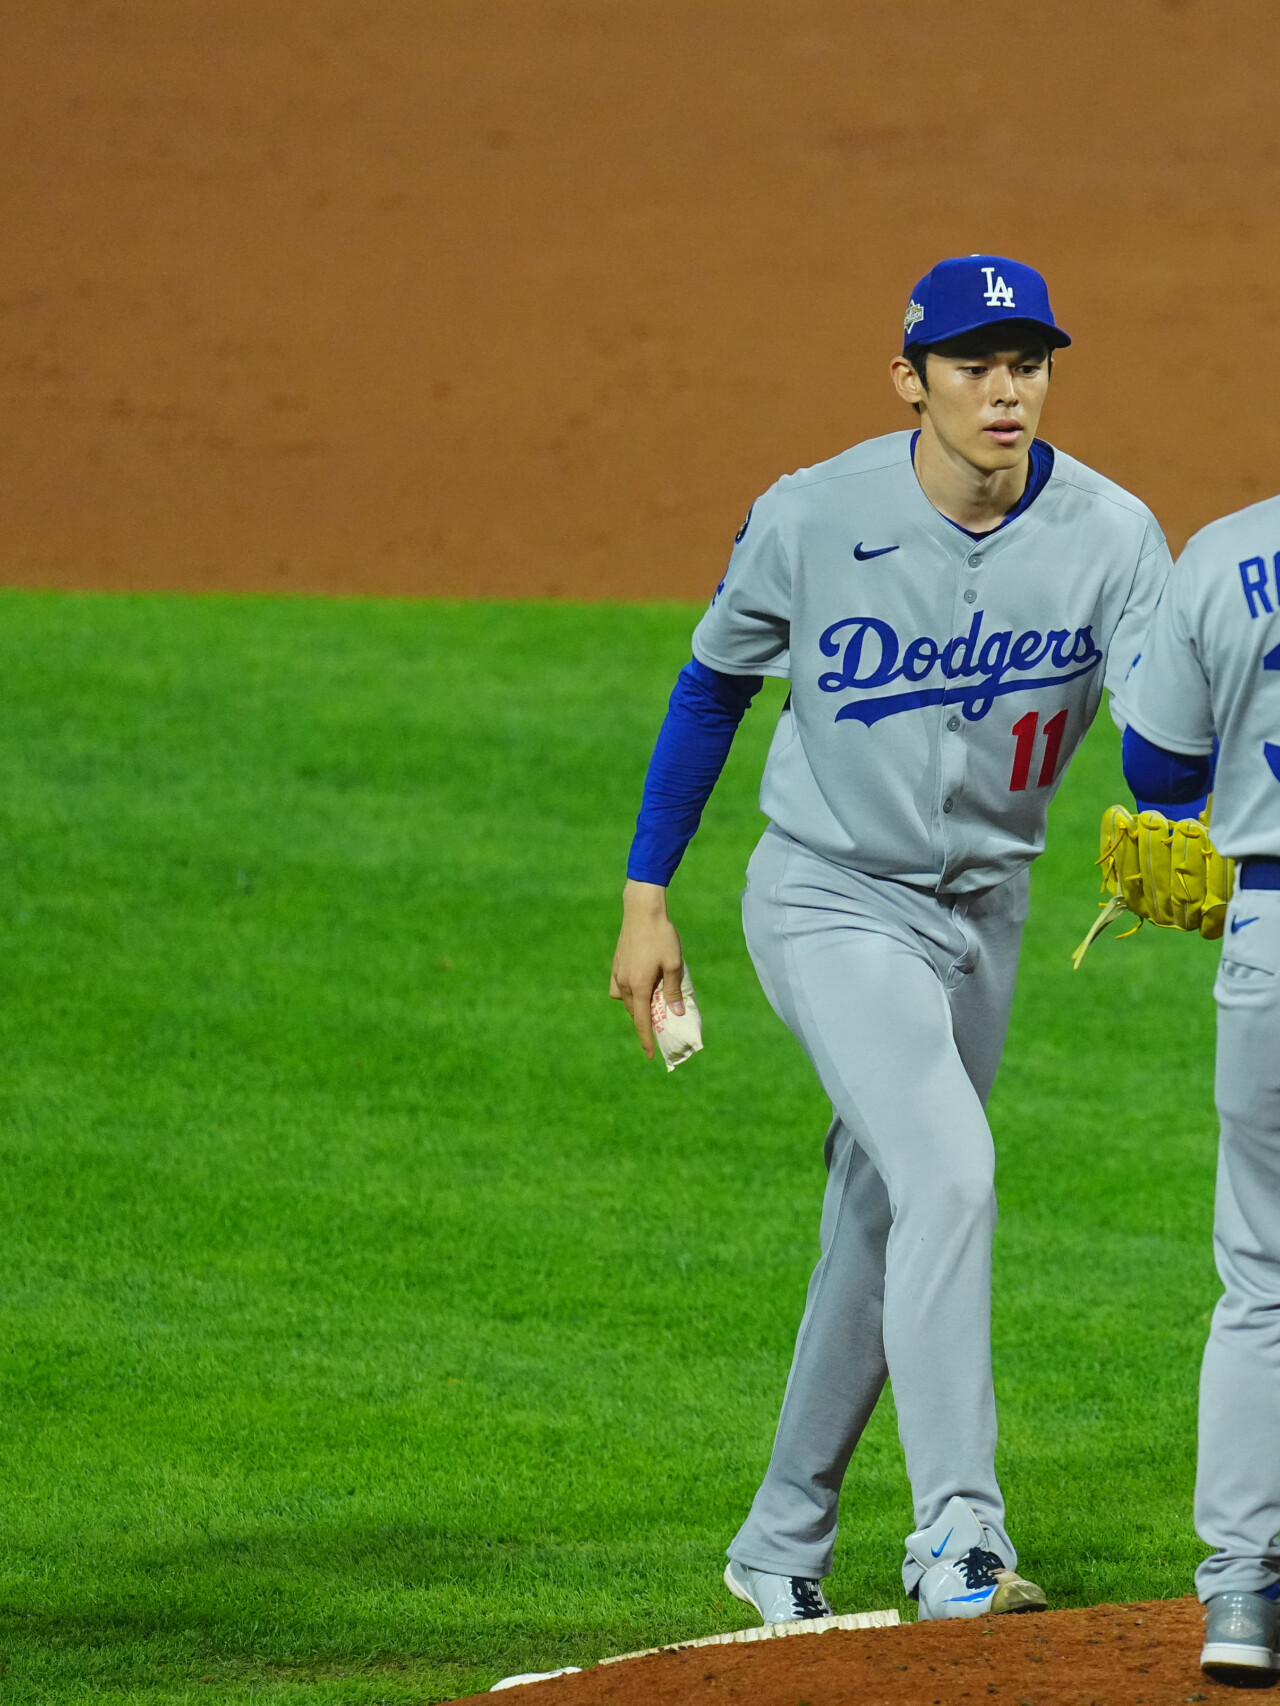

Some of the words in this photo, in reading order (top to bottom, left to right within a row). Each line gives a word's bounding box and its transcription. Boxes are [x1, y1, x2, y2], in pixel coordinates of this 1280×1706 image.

[981, 267, 1016, 308] LA
[818, 610, 1103, 728] Dodgers
[1009, 709, 1067, 791] 11
